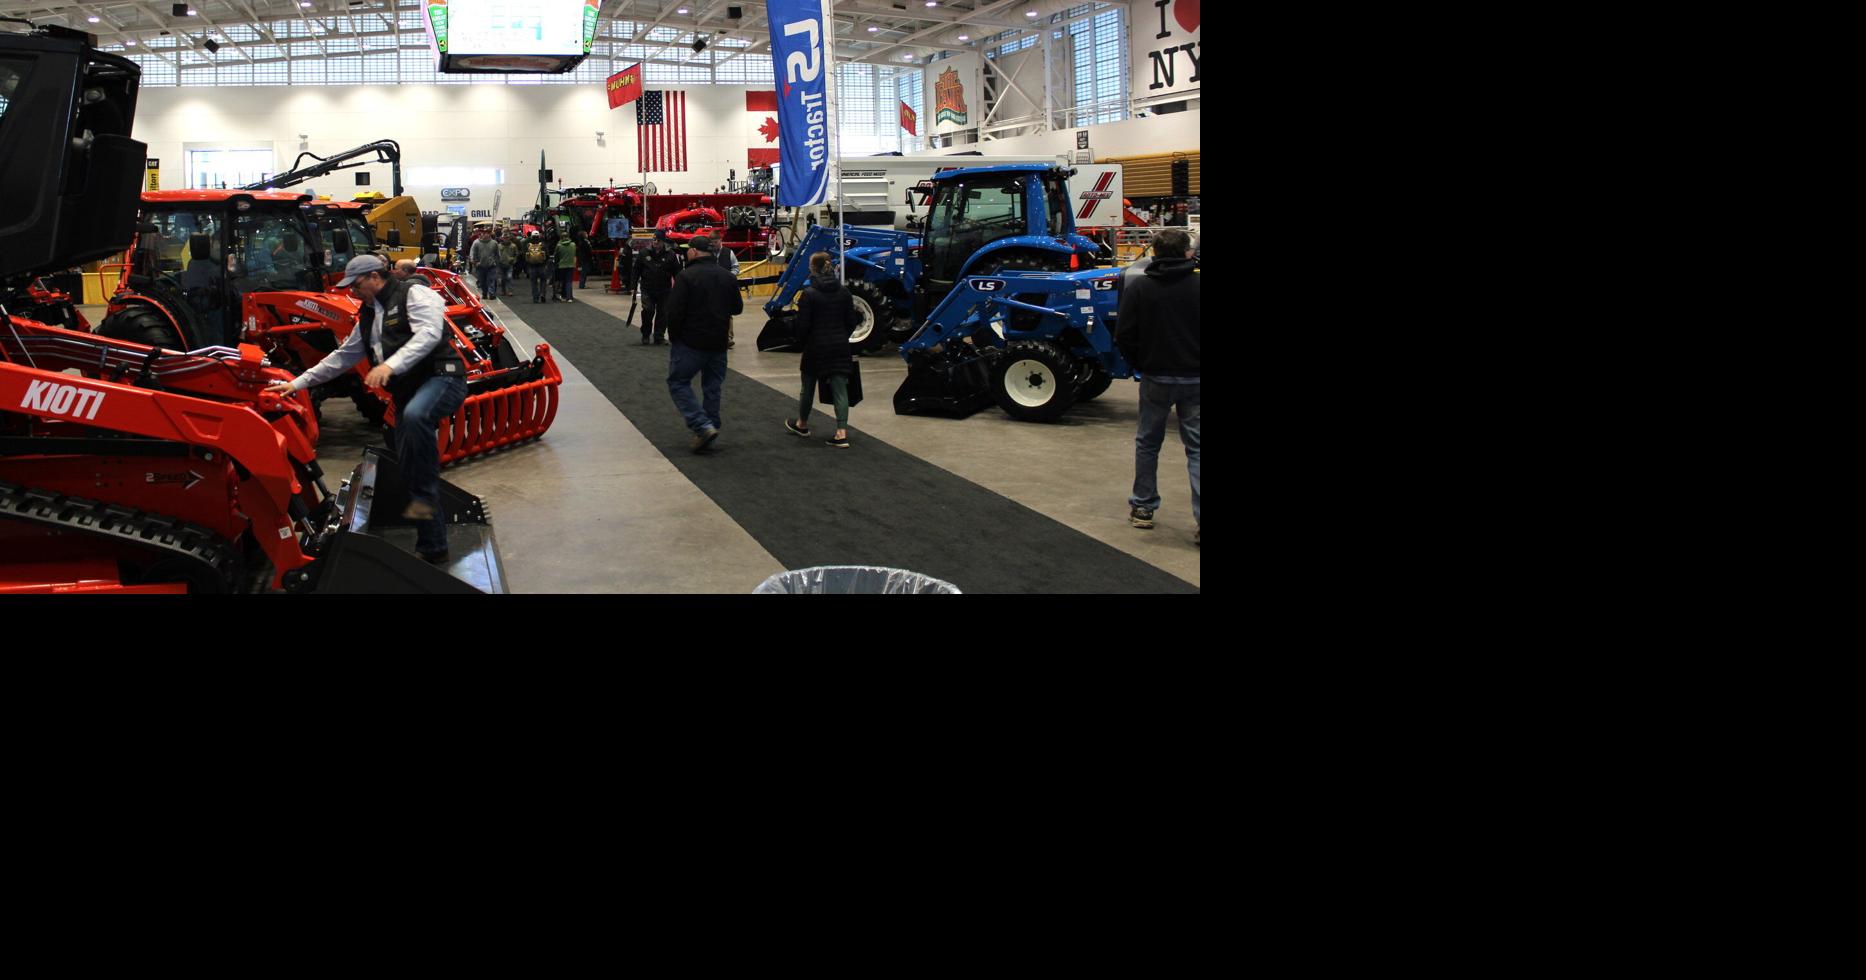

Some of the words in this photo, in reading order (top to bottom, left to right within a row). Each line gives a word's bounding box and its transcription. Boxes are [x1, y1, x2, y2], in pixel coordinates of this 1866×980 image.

[1155, 0, 1171, 39] I
[1149, 42, 1200, 90] NY
[442, 189, 469, 197] EXPO
[471, 210, 491, 218] GRILL
[978, 281, 995, 290] LS
[1094, 280, 1112, 290] LS
[20, 379, 106, 420] KIOTI
